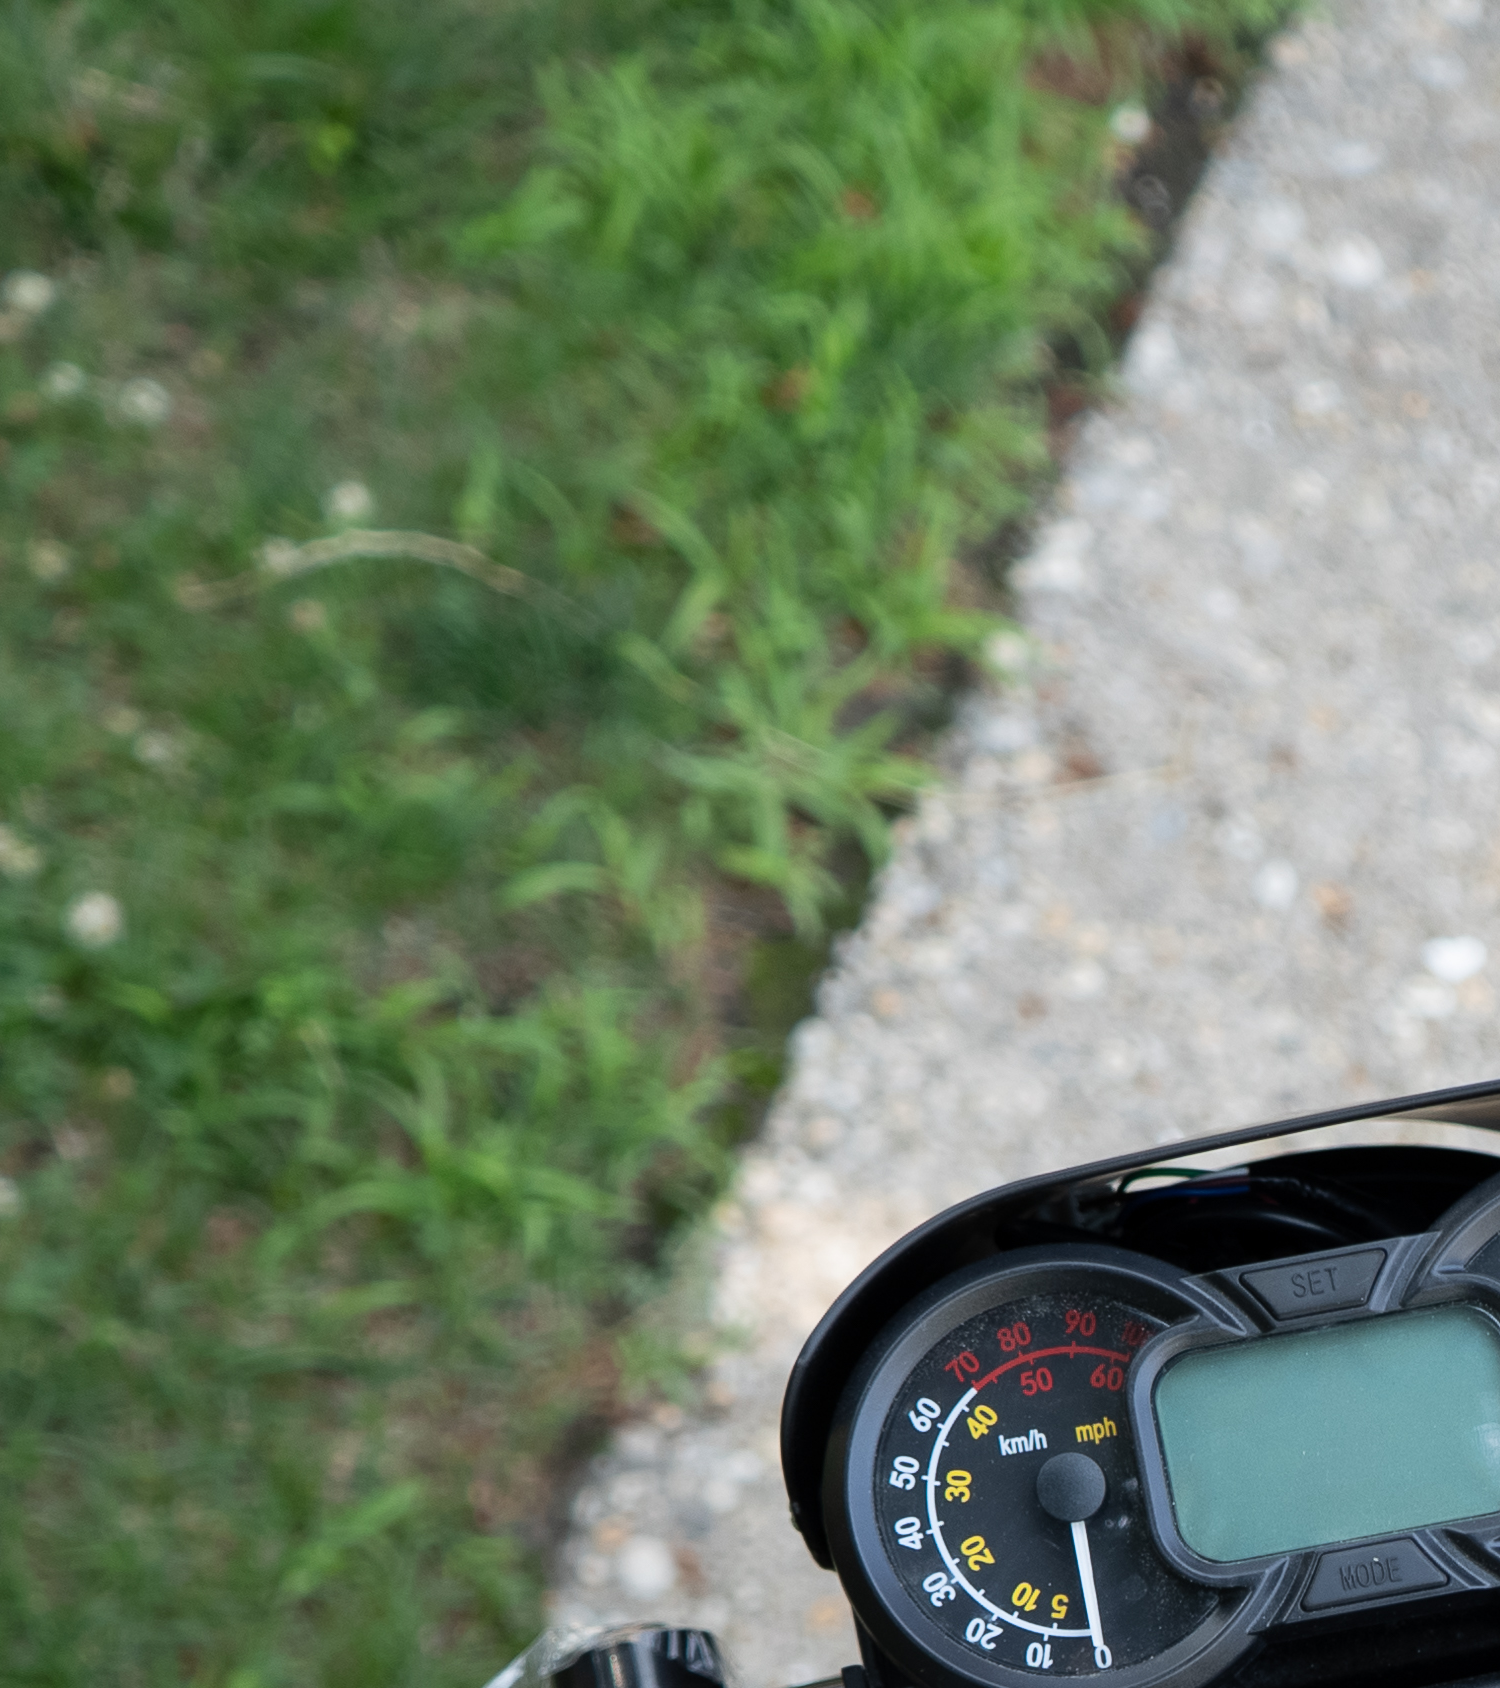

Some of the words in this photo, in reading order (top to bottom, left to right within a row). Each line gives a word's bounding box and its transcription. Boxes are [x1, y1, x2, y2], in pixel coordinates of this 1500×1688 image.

[1291, 1266, 1339, 1299] SET
[997, 1322, 1032, 1351] 80
[1065, 1310, 1097, 1337] 90
[944, 1351, 980, 1383] 70
[1020, 1367, 1053, 1396] 50
[1090, 1365, 1124, 1391] 60
[908, 1397, 941, 1433] 60
[966, 1405, 999, 1440] 40
[1074, 1417, 1118, 1445] mph
[998, 1428, 1048, 1456] km/h
[889, 1456, 920, 1491] 50
[945, 1470, 972, 1503] 30
[894, 1516, 924, 1551] 40
[960, 1535, 996, 1572] 20
[922, 1571, 956, 1607] 30
[1339, 1557, 1403, 1592] MODE
[1011, 1581, 1041, 1612] 10
[1051, 1594, 1069, 1619] 5
[965, 1617, 1004, 1650] 20
[1025, 1642, 1053, 1669] 10
[1094, 1644, 1112, 1669] 0
